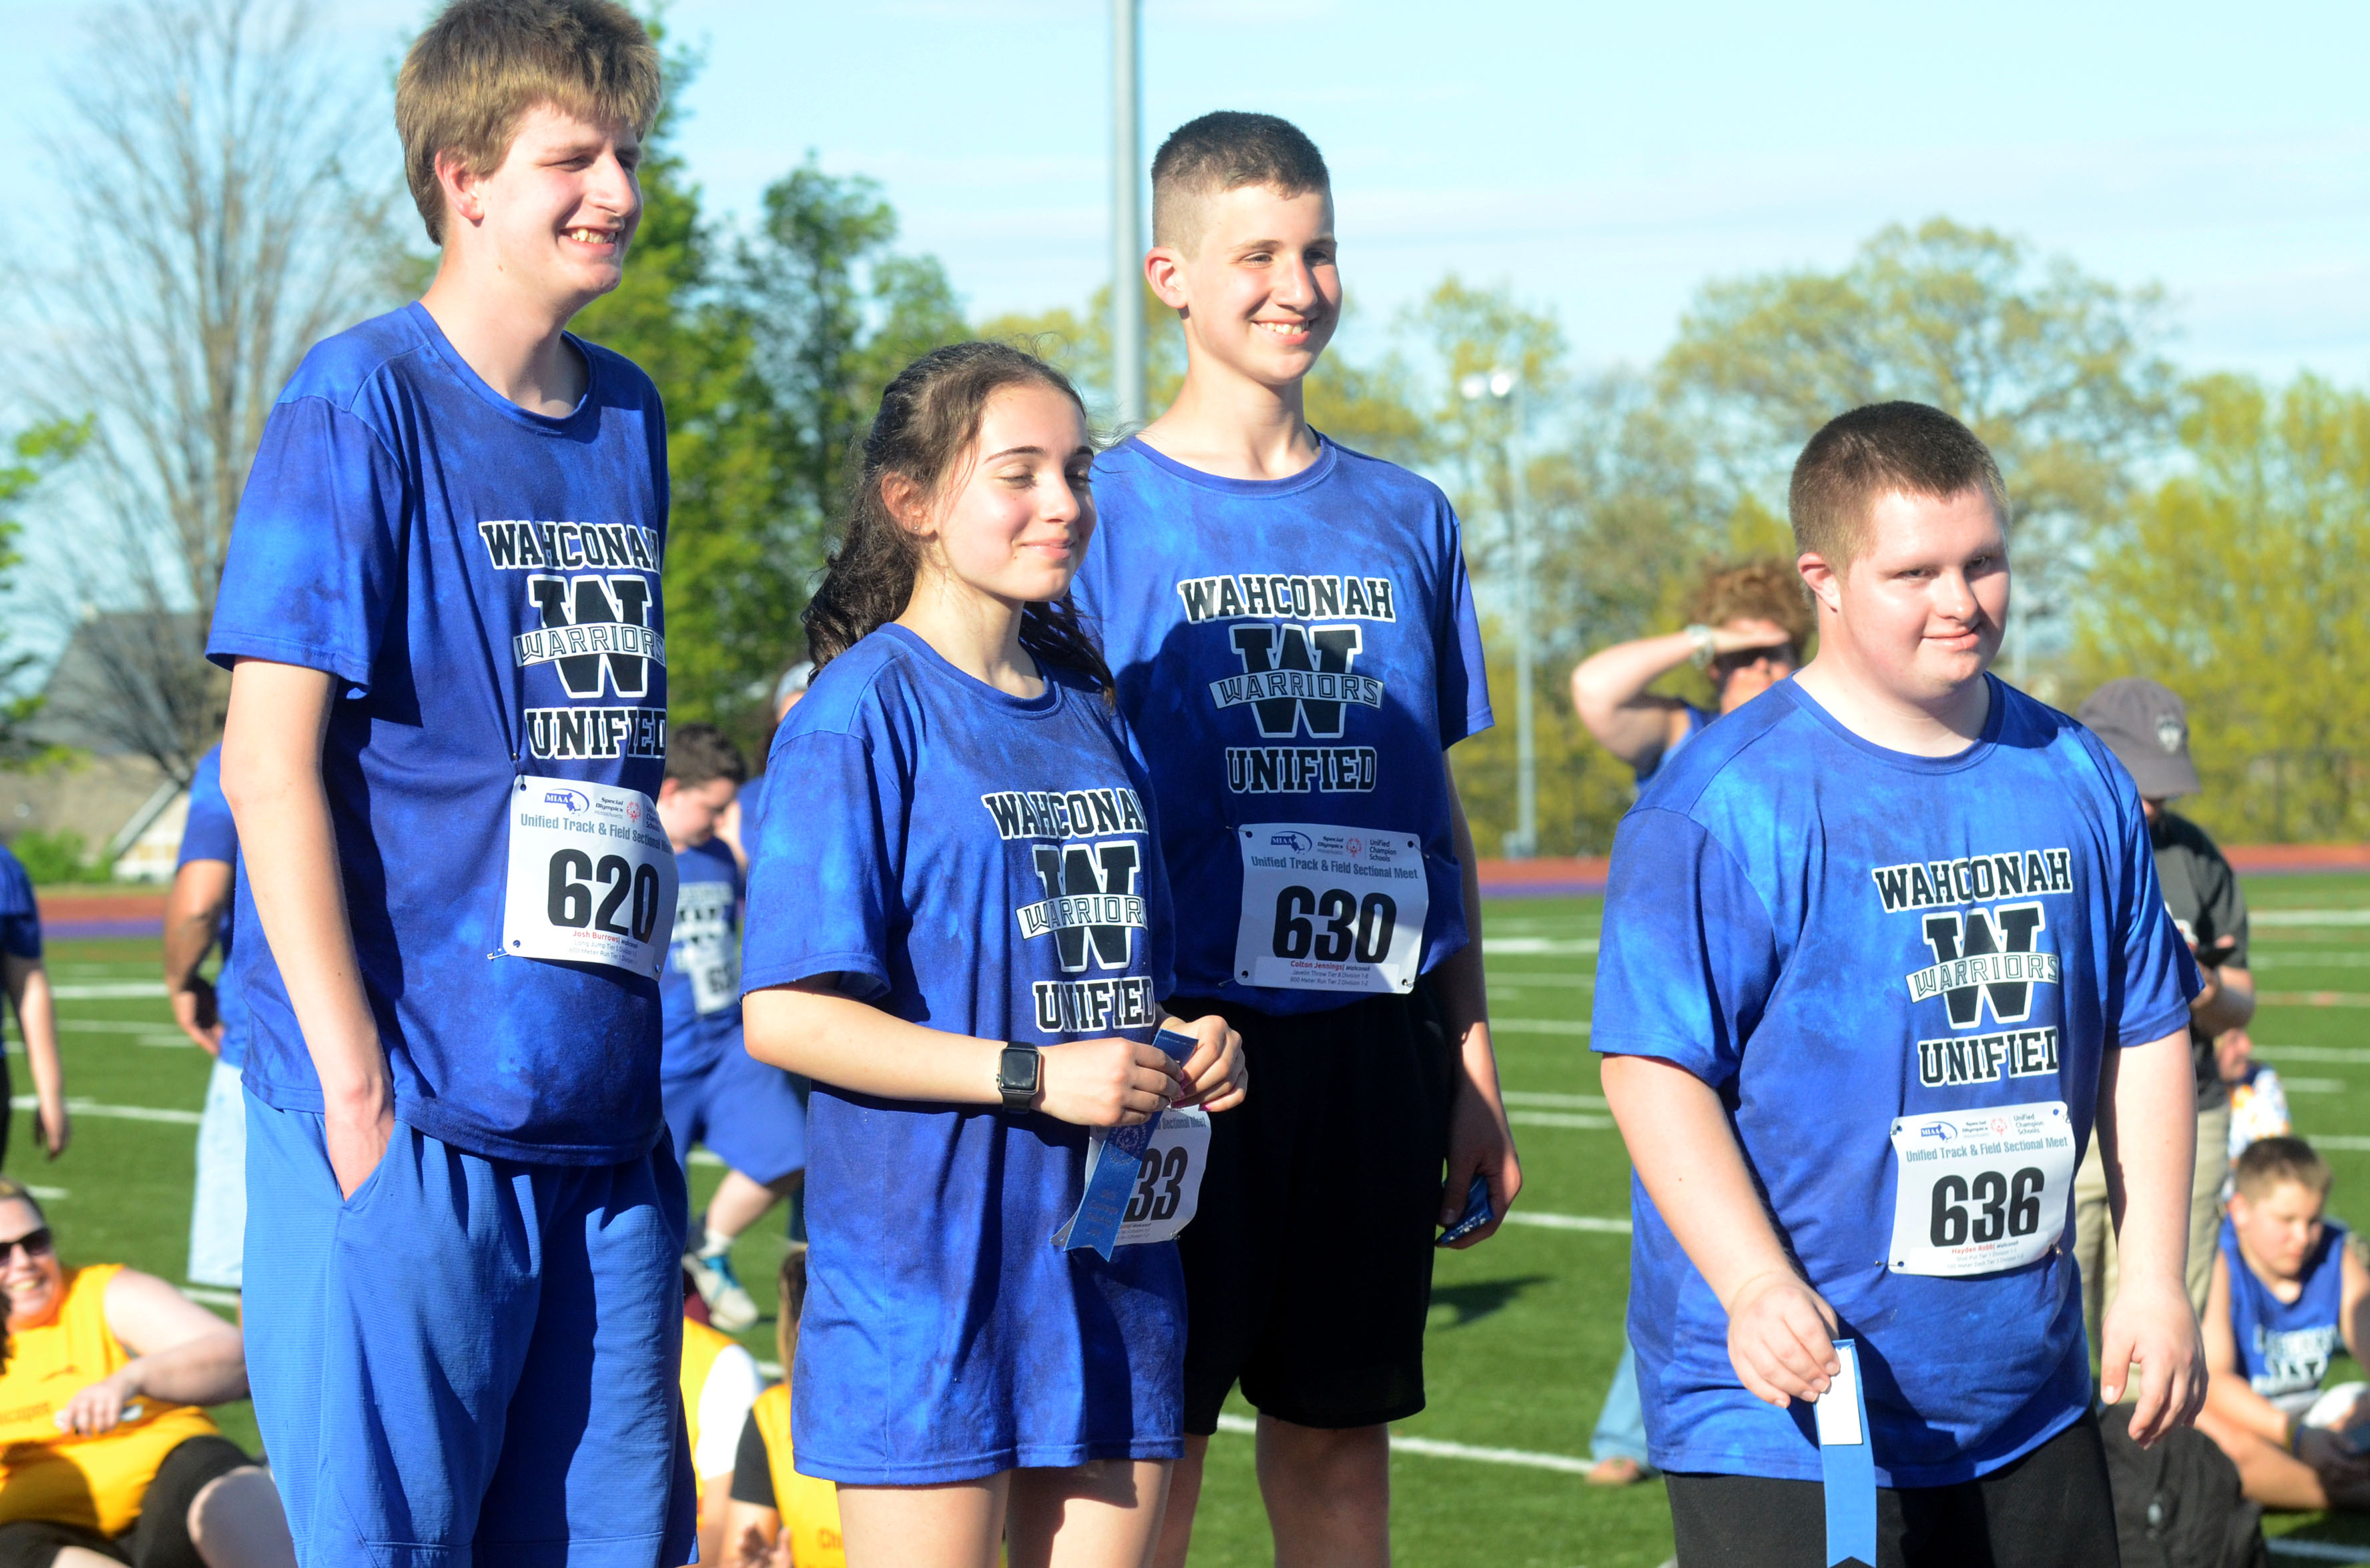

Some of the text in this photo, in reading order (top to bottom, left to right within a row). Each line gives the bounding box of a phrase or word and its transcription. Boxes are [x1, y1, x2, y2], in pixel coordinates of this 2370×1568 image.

[479, 520, 661, 574] WAHCONAH
[1177, 574, 1396, 624] WAHCONAH
[516, 625, 665, 667] WARRIORS
[1218, 671, 1380, 706] WARRIORS
[525, 706, 667, 759] UNIFIED
[1225, 746, 1377, 793] UNIFIED
[545, 793, 569, 803] MIAA
[601, 797, 623, 806] Special
[595, 803, 623, 812] Olympics
[521, 813, 559, 829] Unified
[563, 817, 595, 834] Track
[598, 822, 607, 835] &
[609, 824, 630, 840] Field
[632, 829, 661, 850] Sectional
[1272, 837, 1293, 845] MIAA
[1317, 841, 1344, 850] Olympics
[1370, 839, 1390, 847] Unified
[1369, 846, 1397, 856] Champion
[1369, 853, 1391, 862] Schools
[1251, 856, 1418, 879] Unified Track & Field Sectional Meet
[1871, 847, 2073, 913] WAHCONAH
[547, 848, 659, 944] 620
[1272, 885, 1397, 963] 630
[572, 929, 591, 938] Josh
[1291, 960, 1312, 968] Colton
[1913, 953, 2058, 998] WARRIORS
[1032, 975, 1156, 1033] UNIFIED
[1162, 1115, 1190, 1130] Sectional
[2013, 1113, 2034, 1122] Unified
[2015, 1120, 2044, 1128] Champion
[1921, 1128, 1940, 1136] MIAA
[2017, 1127, 2040, 1135] Schools
[1906, 1136, 2068, 1162] Unified Track & Field Sectional Meet
[1930, 1166, 2044, 1247] 636
[1952, 1246, 1976, 1255] Hayden
